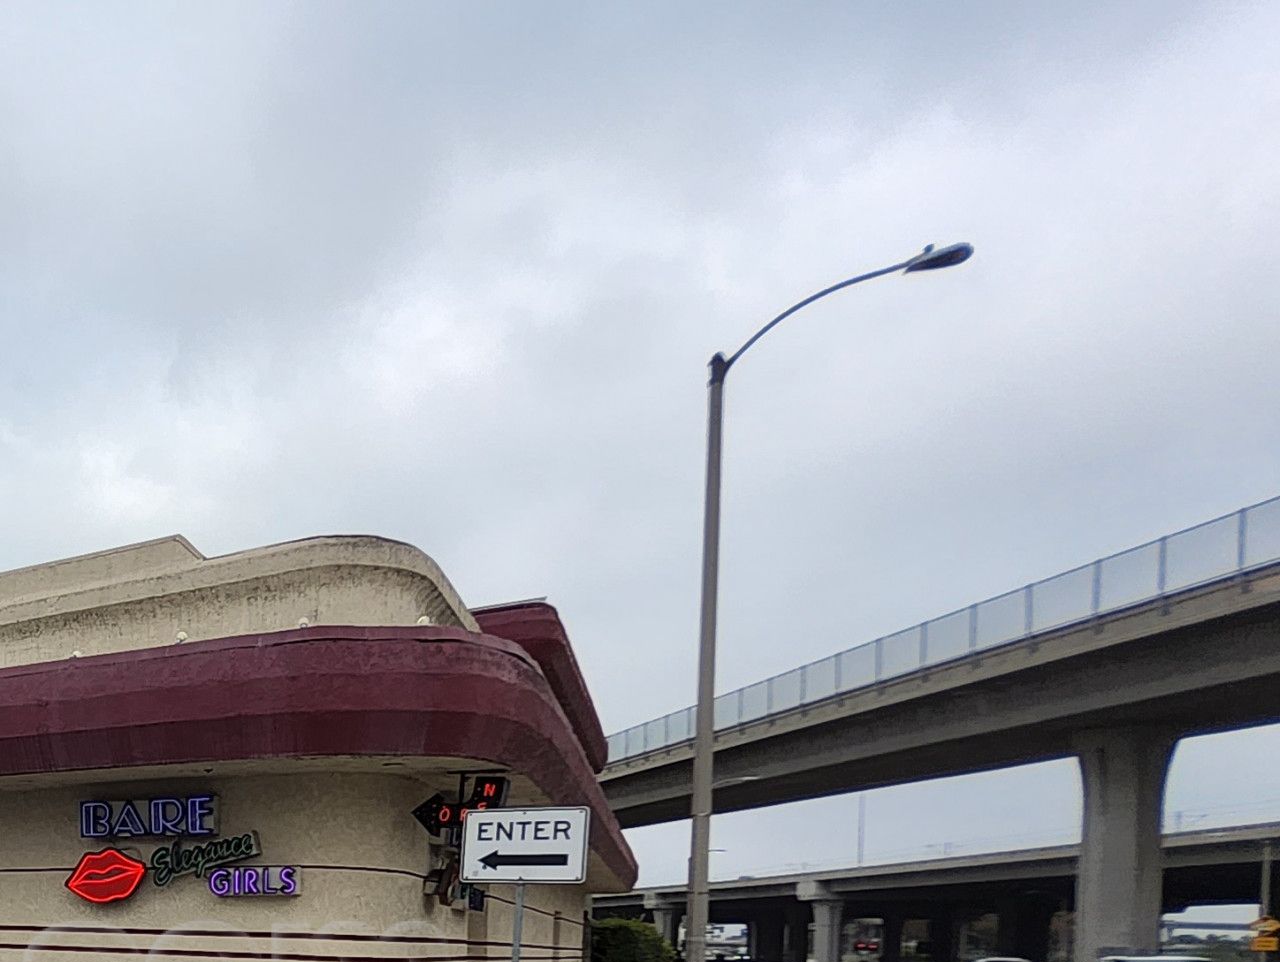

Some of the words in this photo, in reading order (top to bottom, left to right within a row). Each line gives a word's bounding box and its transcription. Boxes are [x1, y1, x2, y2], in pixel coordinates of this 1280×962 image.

[80, 795, 216, 838] BARE
[477, 820, 572, 842] ENTER
[150, 833, 258, 887] Elegance
[209, 866, 297, 895] GIRLS
